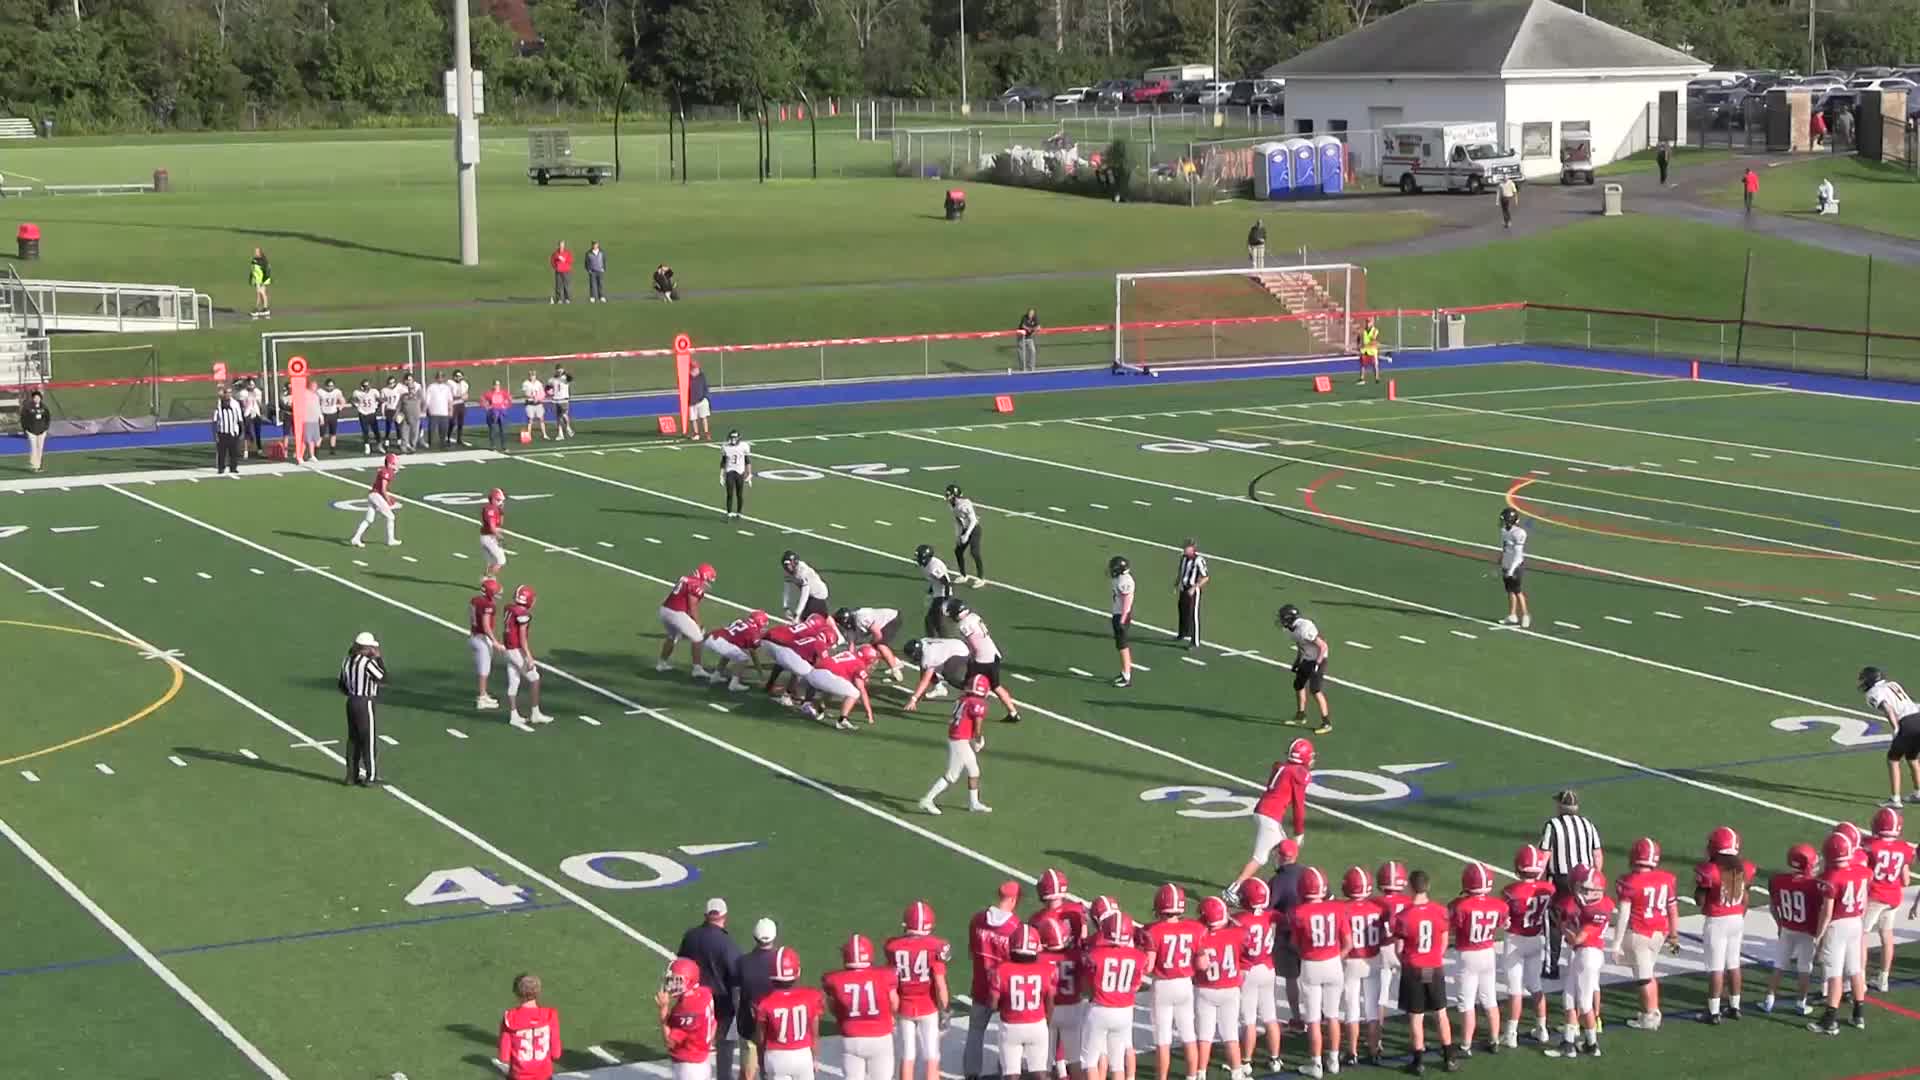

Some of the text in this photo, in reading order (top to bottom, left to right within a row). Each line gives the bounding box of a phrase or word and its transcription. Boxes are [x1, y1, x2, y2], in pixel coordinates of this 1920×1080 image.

[1140, 769, 1414, 818] 30
[404, 850, 695, 906] 40
[1874, 850, 1905, 881] 23
[1643, 884, 1668, 918] 74
[1779, 889, 1806, 923] 89
[1841, 878, 1868, 913] 44
[1248, 923, 1276, 956] 34
[1310, 912, 1336, 947] 81
[1351, 913, 1380, 948] 86
[1418, 920, 1432, 953] 8
[1469, 910, 1499, 943] 62
[895, 949, 930, 982] 84
[1163, 933, 1193, 969] 75
[1204, 944, 1237, 981] 64
[1102, 957, 1136, 993] 60
[843, 981, 879, 1017] 71
[1010, 975, 1042, 1011] 63
[773, 1004, 807, 1044] 70
[516, 1026, 551, 1061] 33
